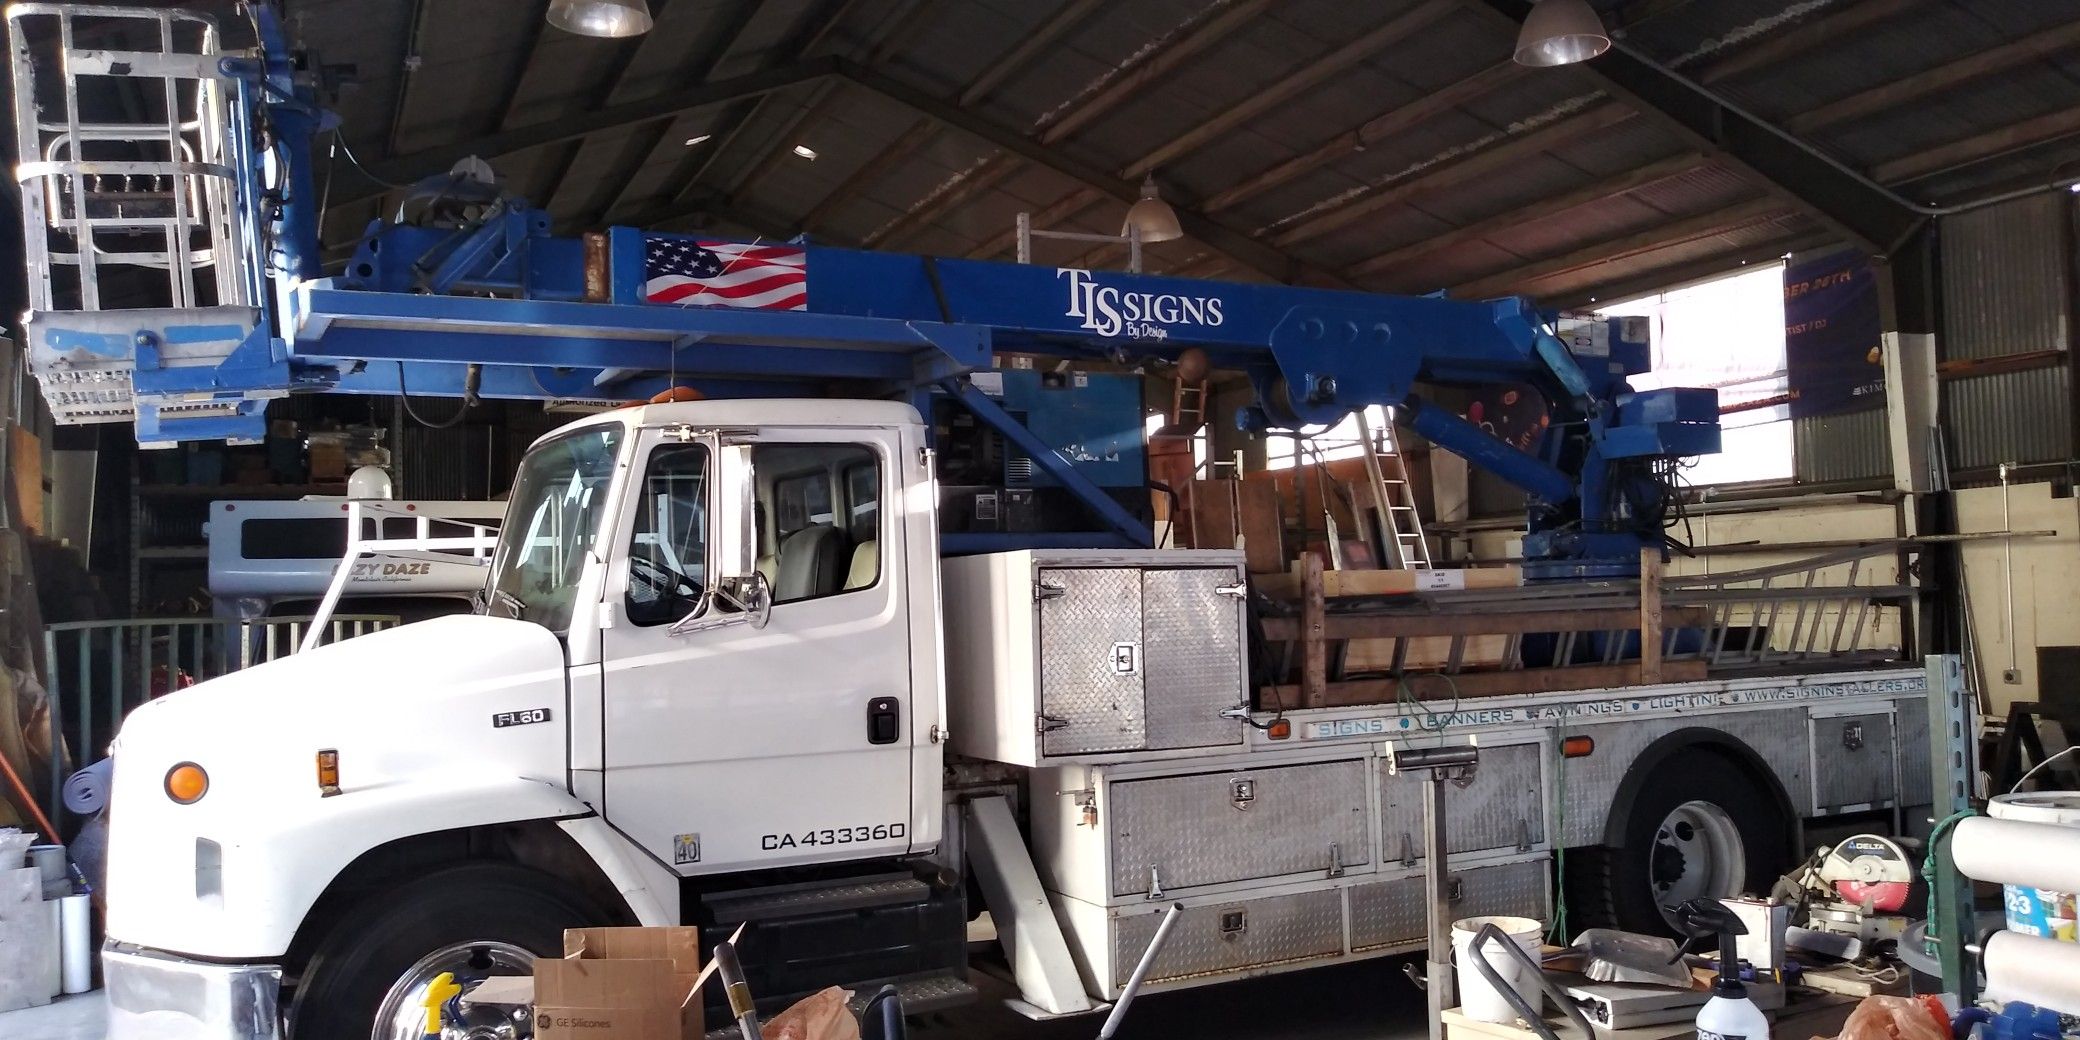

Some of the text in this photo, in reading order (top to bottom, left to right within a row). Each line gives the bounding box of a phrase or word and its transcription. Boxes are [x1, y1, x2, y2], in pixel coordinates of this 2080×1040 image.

[1123, 292, 1224, 327] SIGNS
[1126, 321, 1168, 342] By Design
[382, 563, 431, 575] DAZE
[497, 709, 545, 727] FL60
[1319, 719, 1383, 737] SIGNS
[1426, 709, 1514, 728] BANNERS
[1544, 700, 1624, 719] AWNNGS
[677, 841, 698, 861] 40
[1856, 842, 1886, 850] DELTA
[556, 1017, 612, 1029] GE Silicones
